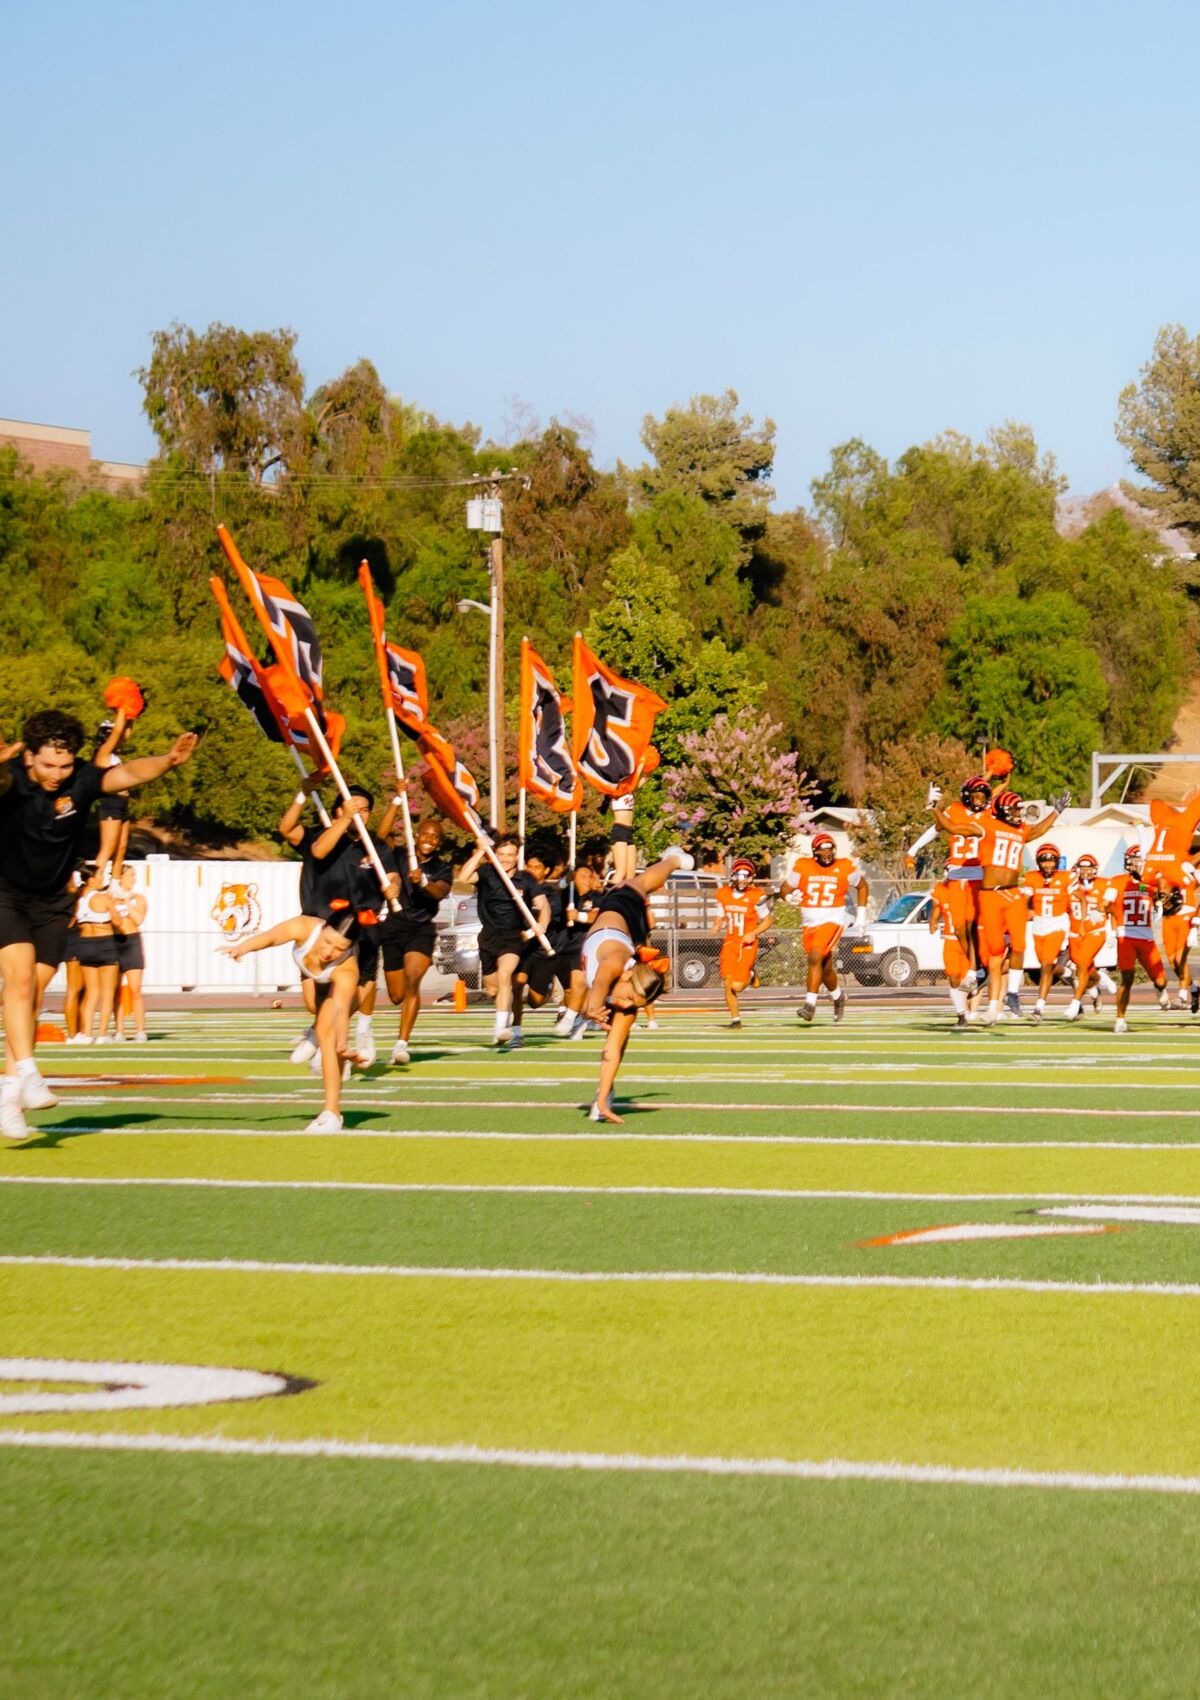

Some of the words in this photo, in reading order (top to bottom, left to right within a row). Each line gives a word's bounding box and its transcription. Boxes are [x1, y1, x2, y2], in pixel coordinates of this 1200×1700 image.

[953, 834, 979, 859] 23
[992, 838, 1023, 870] 88
[807, 883, 837, 906] 55
[1042, 895, 1054, 918] 6
[726, 912, 745, 937] 14
[1123, 899, 1149, 926] 29
